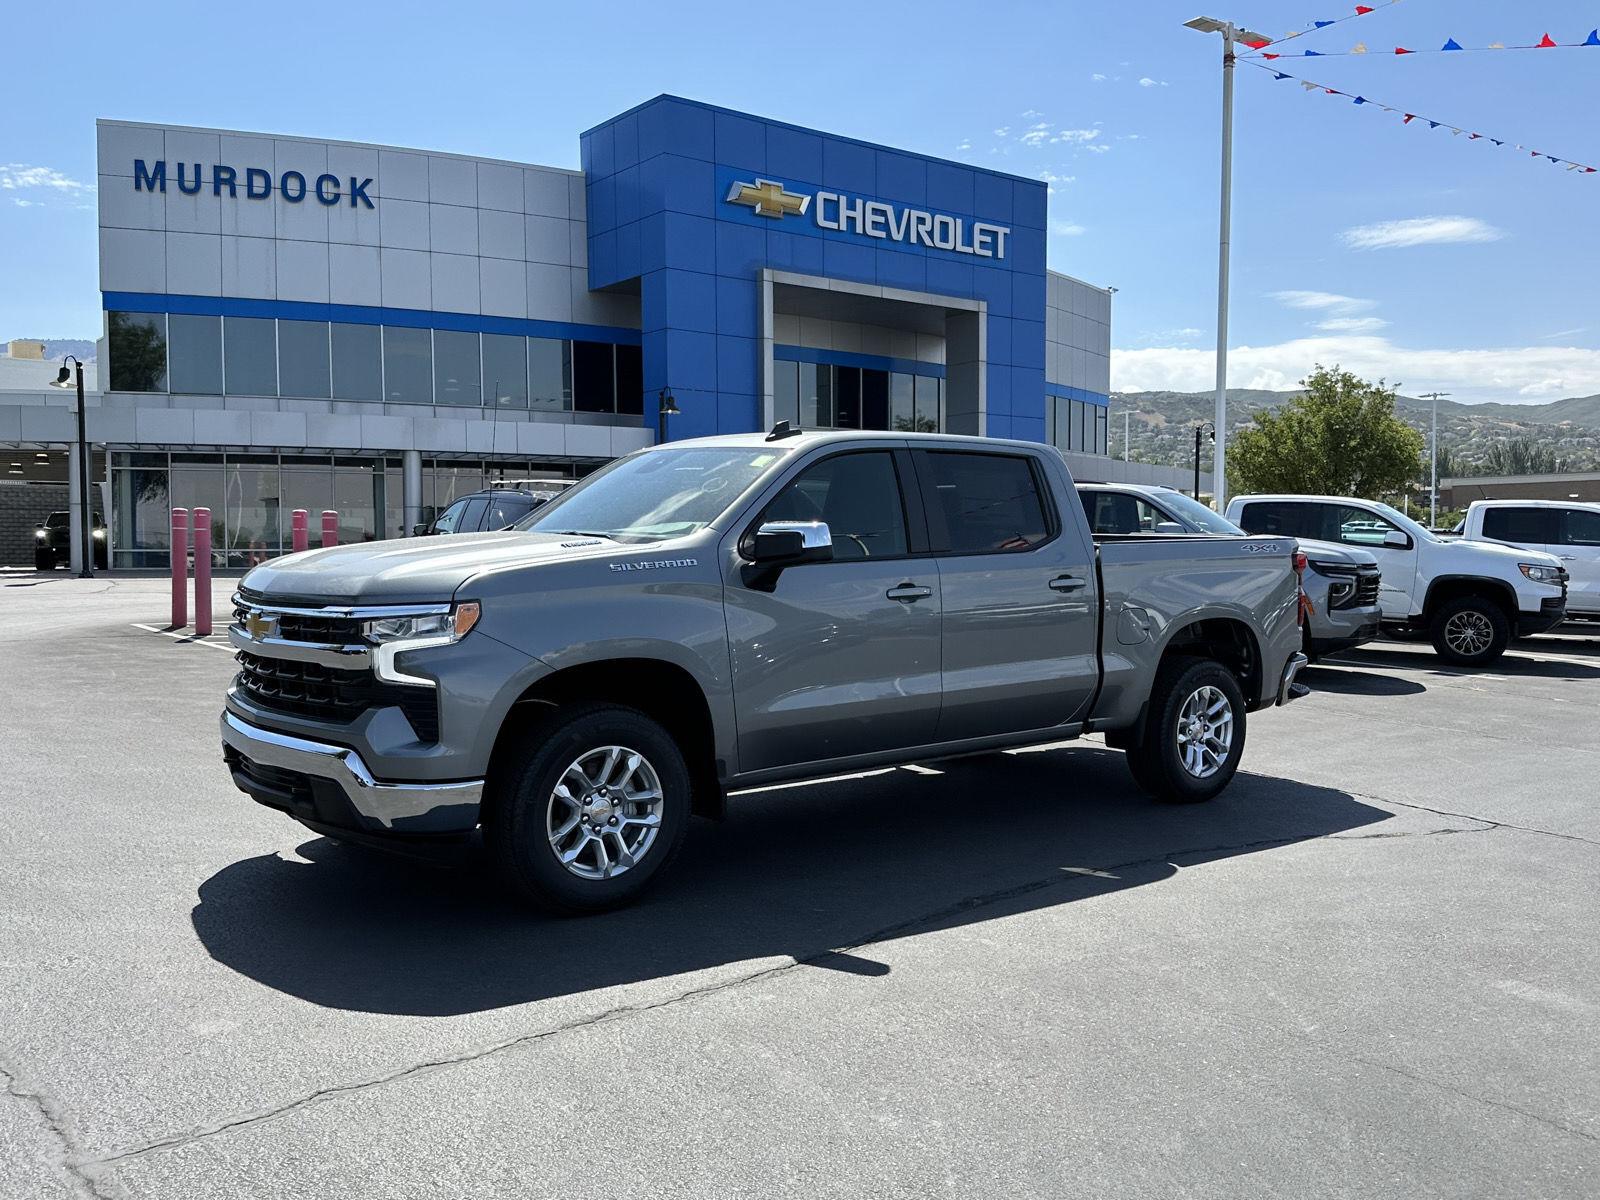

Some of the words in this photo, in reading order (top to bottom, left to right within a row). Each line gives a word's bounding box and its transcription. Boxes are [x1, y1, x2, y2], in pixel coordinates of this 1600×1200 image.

[134, 159, 375, 209] MURDOCK
[816, 191, 1010, 259] CHEVROLET
[609, 558, 698, 572] SILVERADO
